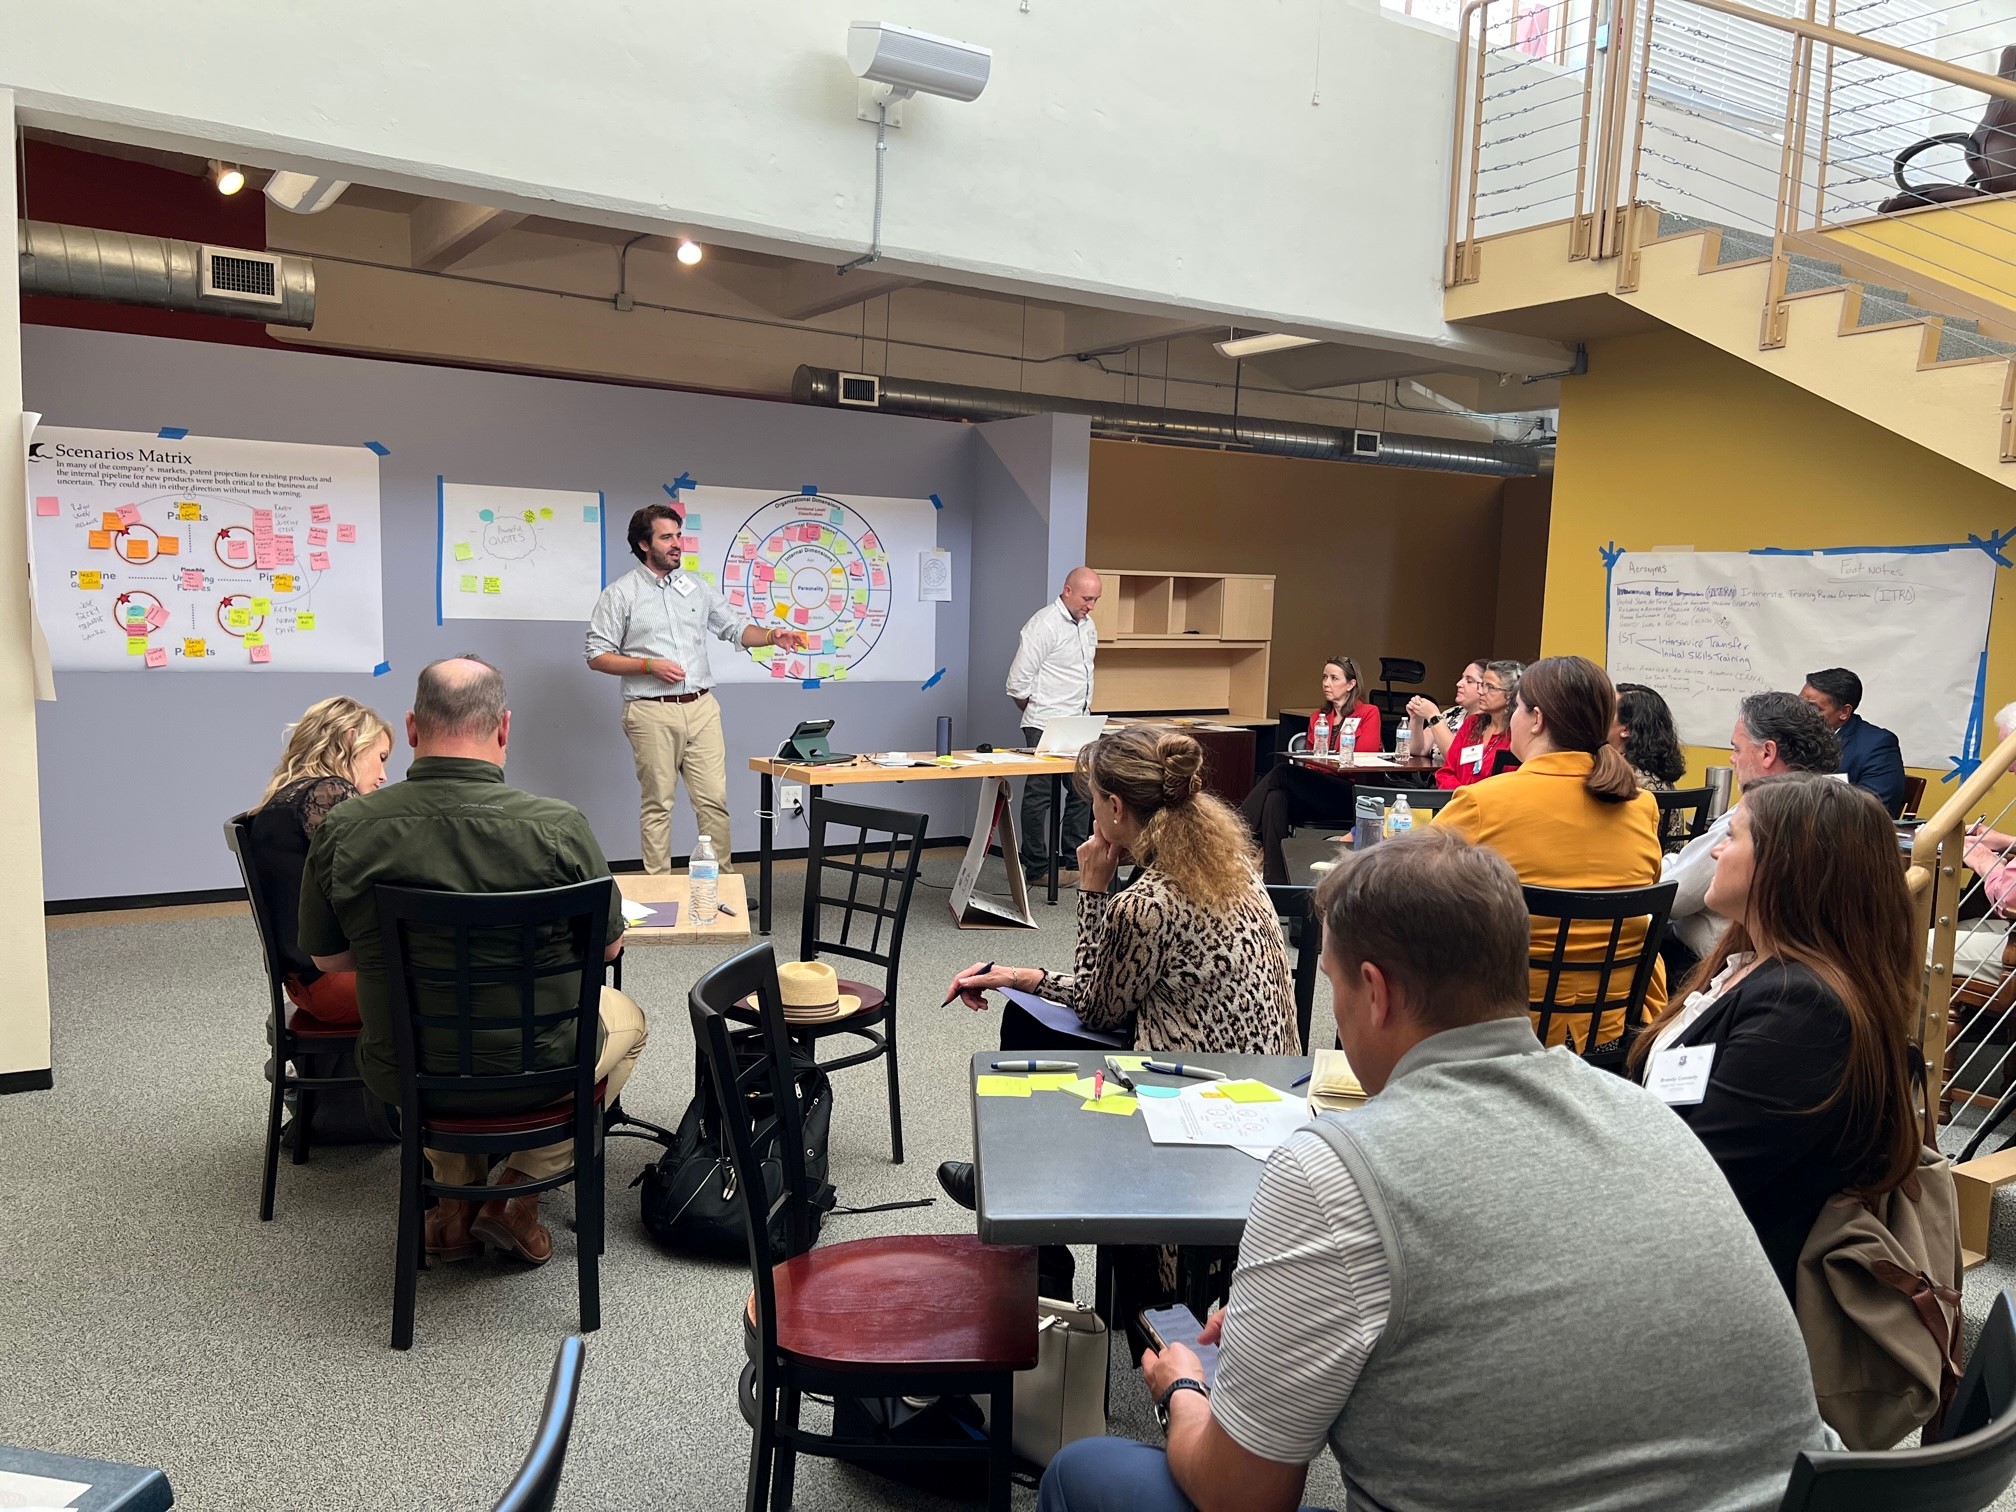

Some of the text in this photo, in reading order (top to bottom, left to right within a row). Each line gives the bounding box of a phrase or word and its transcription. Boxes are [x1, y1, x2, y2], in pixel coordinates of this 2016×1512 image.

[55, 444, 192, 464] Scenarios Matrix
[66, 462, 87, 470] many
[214, 471, 248, 479] projection
[261, 473, 288, 482] existing
[289, 475, 318, 483] products
[71, 471, 100, 479] internal
[102, 472, 132, 481] pipeline
[163, 475, 195, 484] products
[214, 477, 231, 485] both
[232, 478, 255, 487] critical
[265, 480, 277, 488] the
[277, 481, 306, 489] business
[57, 479, 95, 487] uncertain.
[98, 479, 117, 489] They
[119, 481, 140, 489] could
[141, 482, 158, 490] shift
[168, 483, 188, 492] either
[190, 485, 222, 493] direction
[223, 487, 250, 495] without
[774, 497, 841, 511] Organizational Dimensions
[489, 533, 525, 545] QUOTES
[785, 548, 804, 562] Internal
[1629, 561, 1667, 576] Acronyms
[1839, 559, 1863, 576] Foot
[1789, 589, 1817, 601] Training
[1874, 586, 1916, 605] (ITRO)
[1658, 635, 1750, 651] Interservice Transfer
[1661, 648, 1685, 659] Initial
[1712, 653, 1752, 671] Training
